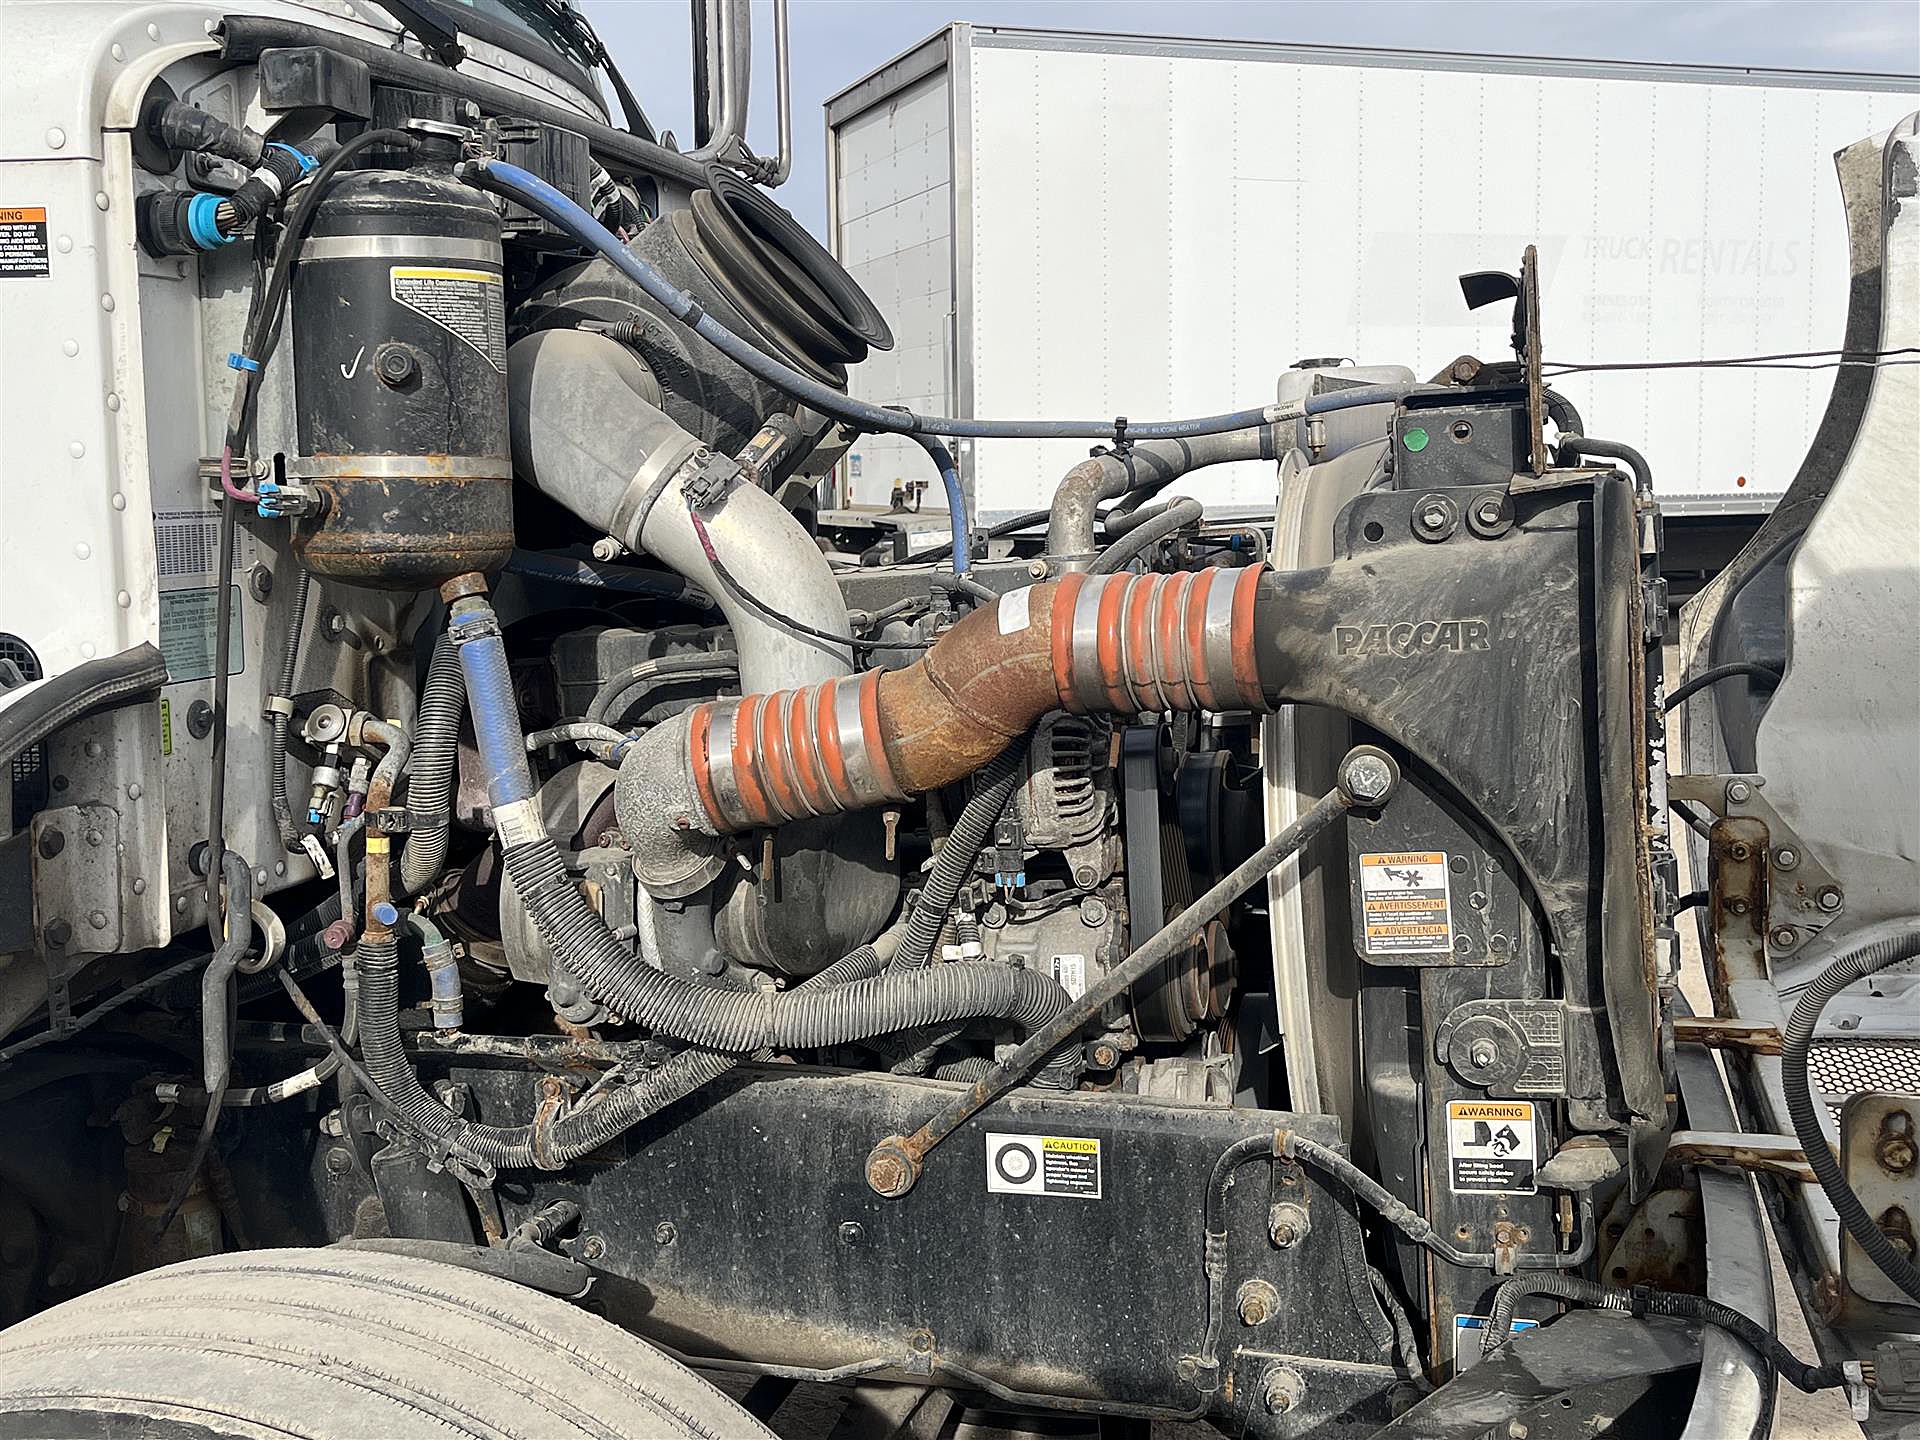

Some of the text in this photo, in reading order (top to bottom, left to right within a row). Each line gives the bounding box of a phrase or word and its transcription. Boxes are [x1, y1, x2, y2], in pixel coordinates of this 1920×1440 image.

[1583, 235, 1800, 275] TRUCK RENTALS
[1335, 619, 1491, 658] PACCAR
[1388, 855, 1428, 863] WARNING
[1379, 900, 1444, 910] AVERTISSEMENT
[1385, 926, 1443, 935] ADVERTENCIA
[1469, 1107, 1523, 1117] WARNING
[1053, 1141, 1096, 1151] CAUTION
